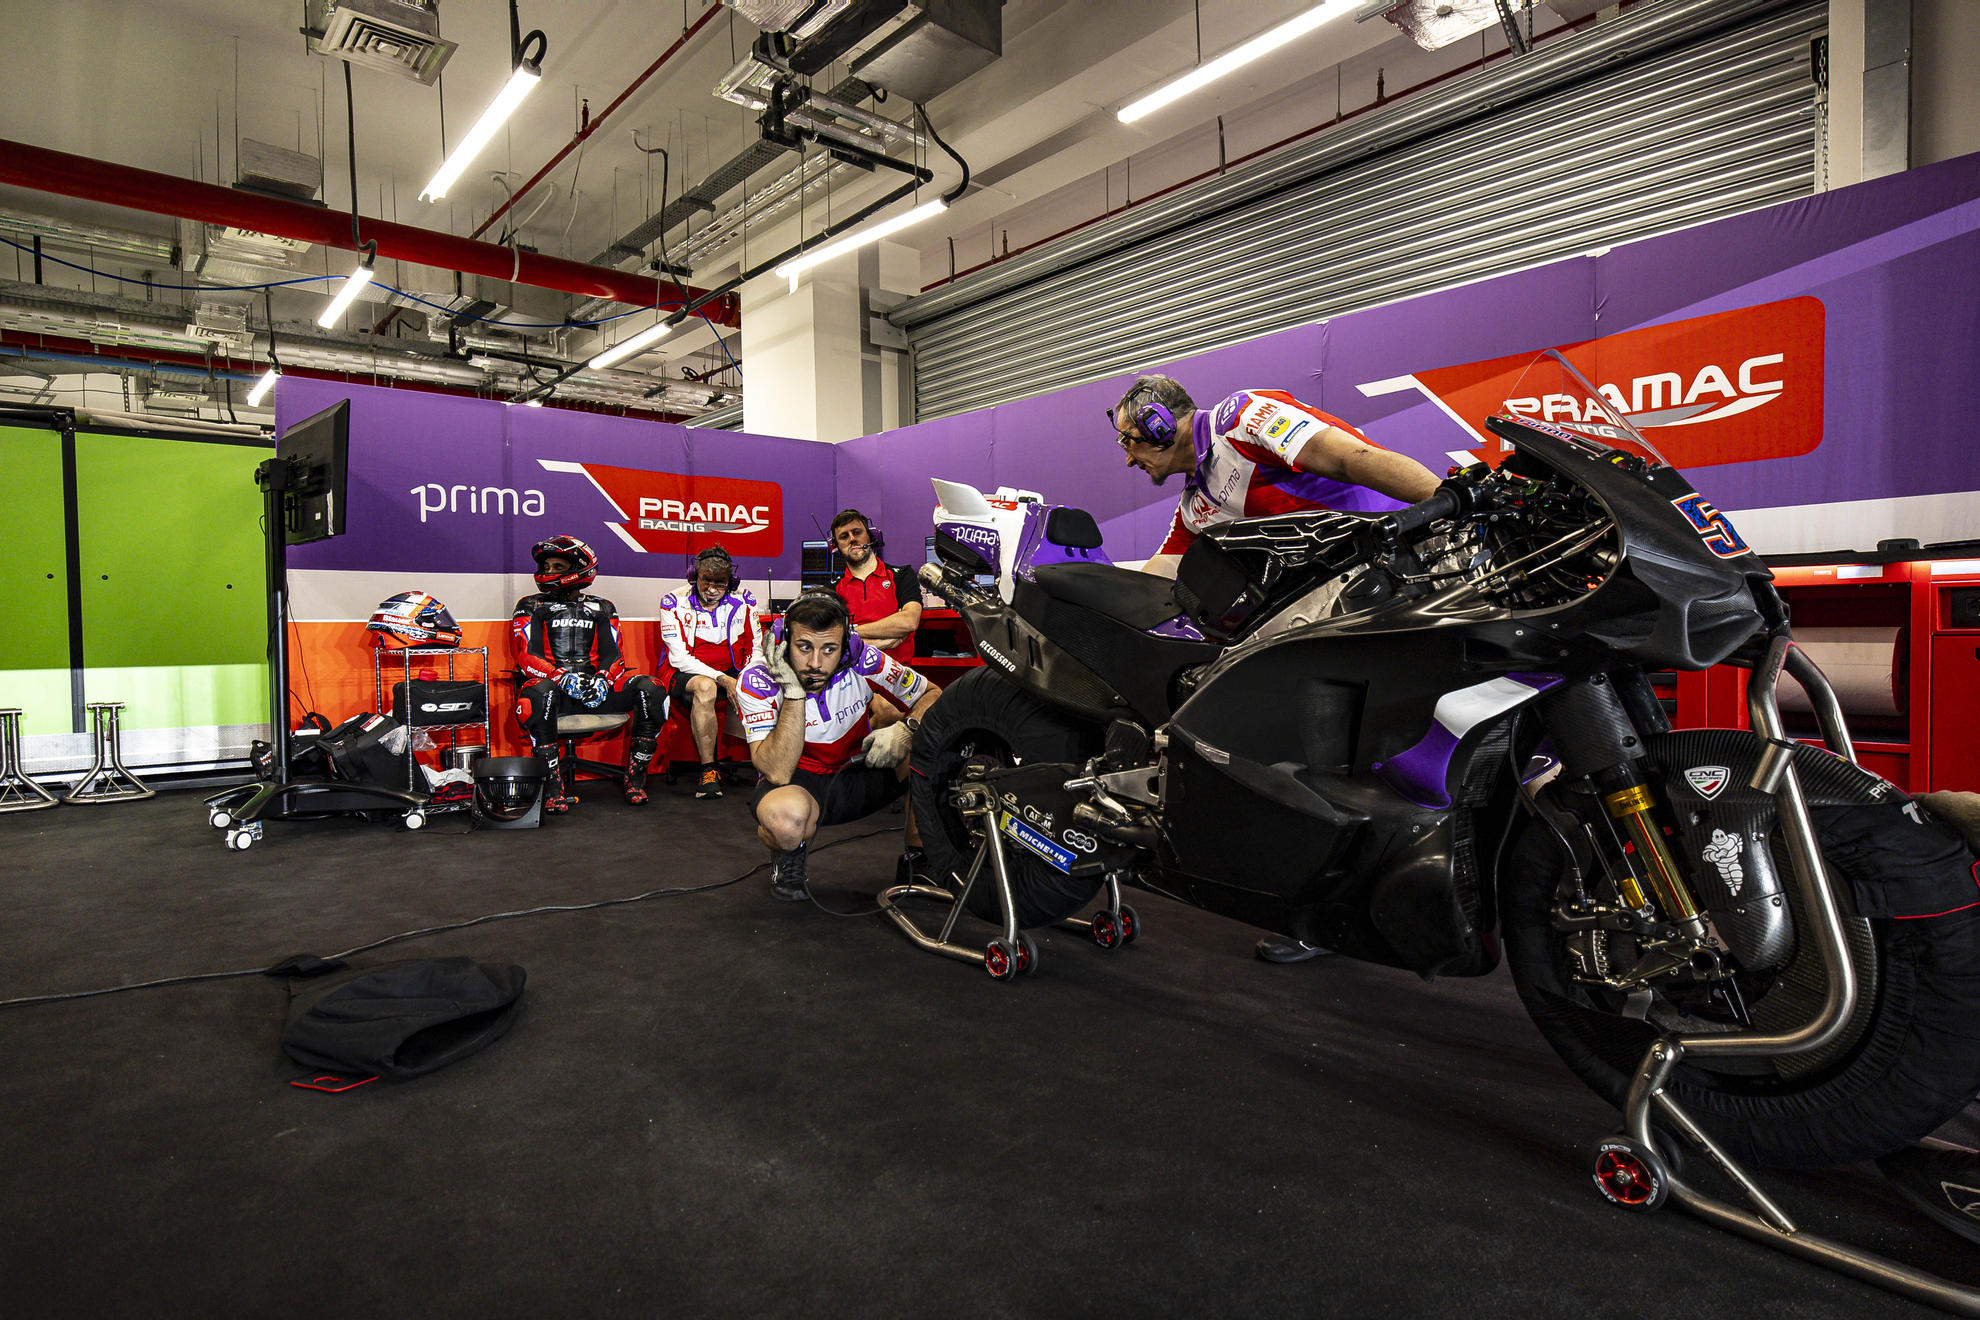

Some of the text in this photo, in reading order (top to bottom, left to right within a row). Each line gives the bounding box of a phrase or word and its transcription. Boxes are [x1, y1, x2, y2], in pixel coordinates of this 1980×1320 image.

[1503, 353, 1784, 423] PRAMAC
[1246, 403, 1278, 436] FIAMM
[1219, 468, 1241, 505] prima
[410, 483, 545, 523] prima
[639, 497, 770, 526] PRAMAC
[640, 519, 705, 532] RACING
[951, 526, 997, 546] prima
[551, 619, 594, 629] DUCATI
[526, 665, 547, 679] DUCATI
[747, 711, 773, 723] MOTUL
[1019, 830, 1068, 864] MICHELIN
